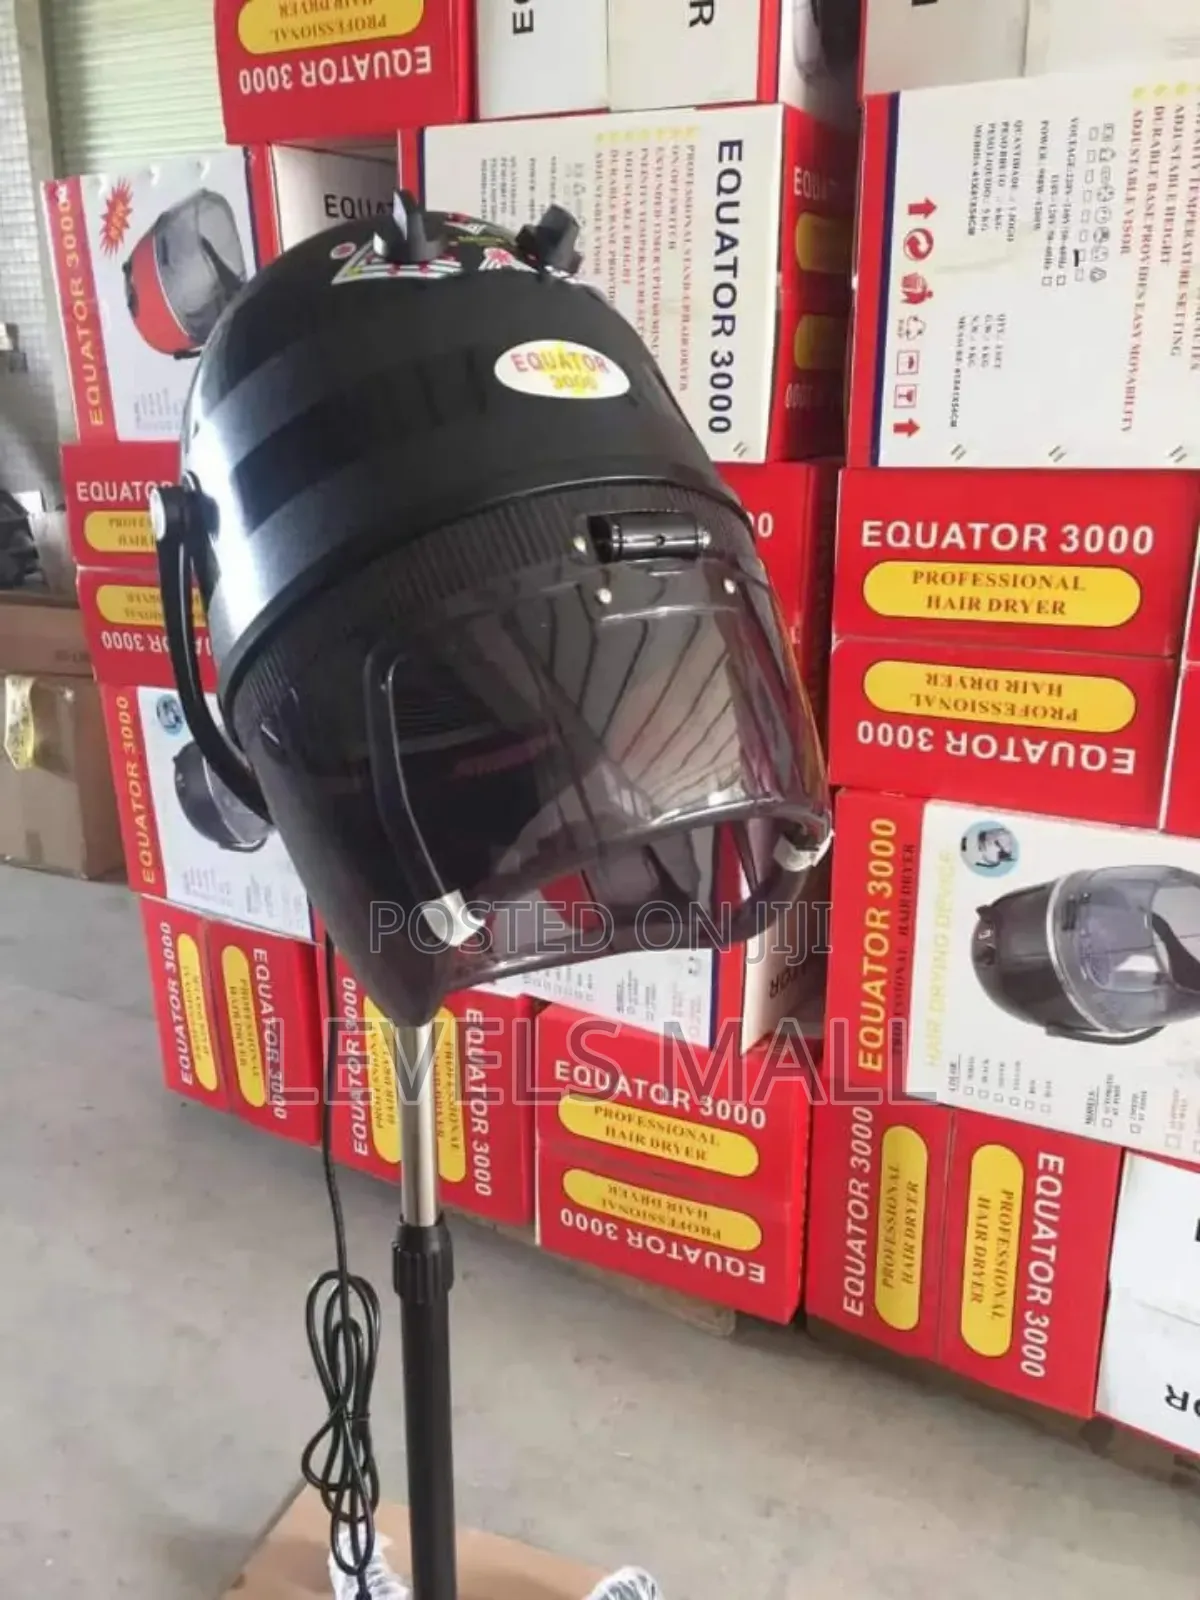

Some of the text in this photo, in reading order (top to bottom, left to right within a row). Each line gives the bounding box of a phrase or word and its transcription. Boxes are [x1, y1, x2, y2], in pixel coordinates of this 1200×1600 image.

[239, 45, 432, 95] EQUATOR 3000
[708, 139, 743, 434] EQUATOR 3000
[68, 277, 104, 426] EQUATOR
[510, 351, 610, 374] EQUATOR
[861, 520, 1155, 555] EQUATOR 3000
[912, 570, 1086, 592] PROFESSIONAL
[102, 630, 144, 652] 3000
[926, 595, 1067, 616] HAIR DRYER
[911, 693, 1079, 722] PROFESSIONAL
[926, 672, 1063, 698] HAIR DRYER
[116, 696, 155, 884] EQUATOR 3000
[857, 720, 1136, 775] EQUATOR 3000
[858, 818, 896, 1072] EQUATOR 3000
[160, 921, 193, 1086] EQUATOR 3000
[253, 948, 287, 1119] EQUATOR 3000
[342, 977, 368, 1156] EQUATOR 3000
[466, 1008, 491, 1196] EQUATOR 3000
[555, 1060, 767, 1129] EQUATOR 3000
[594, 1106, 719, 1146] PROFESSIONAL
[605, 1125, 708, 1162] HAIR DRYER
[560, 1208, 766, 1284] EQUATOR 3000
[844, 1106, 873, 1316] EQUATOR 3000
[882, 1163, 900, 1290] PROFESSIONAL
[902, 1180, 919, 1285] HAIR DRYER
[971, 1196, 991, 1304] HAIR DRYER
[991, 1189, 1014, 1320] PROFESSIONAL
[1021, 1152, 1064, 1378] EQUATOR 3000
